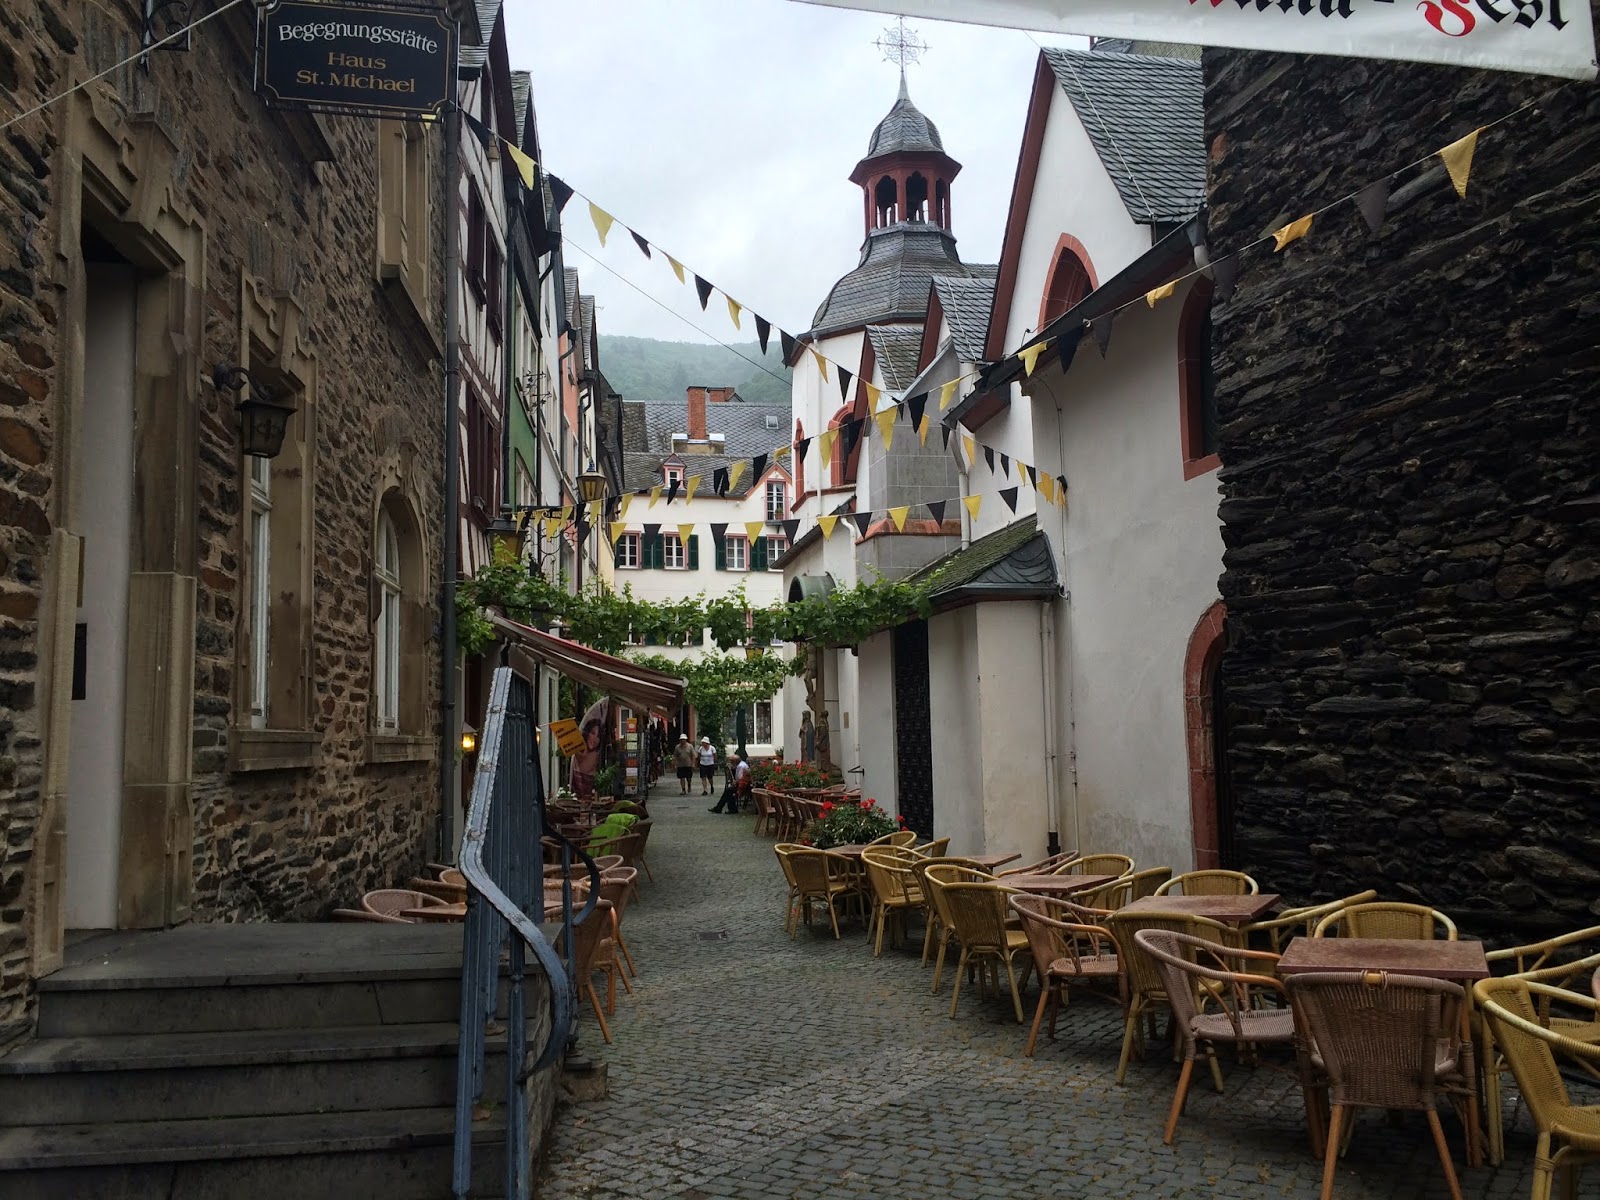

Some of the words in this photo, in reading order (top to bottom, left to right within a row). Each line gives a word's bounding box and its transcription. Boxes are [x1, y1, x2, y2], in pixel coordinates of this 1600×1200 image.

[278, 21, 438, 54] Begegnungsstätte
[327, 52, 386, 70] Haus
[296, 69, 325, 86] St.
[329, 72, 416, 93] Michael
